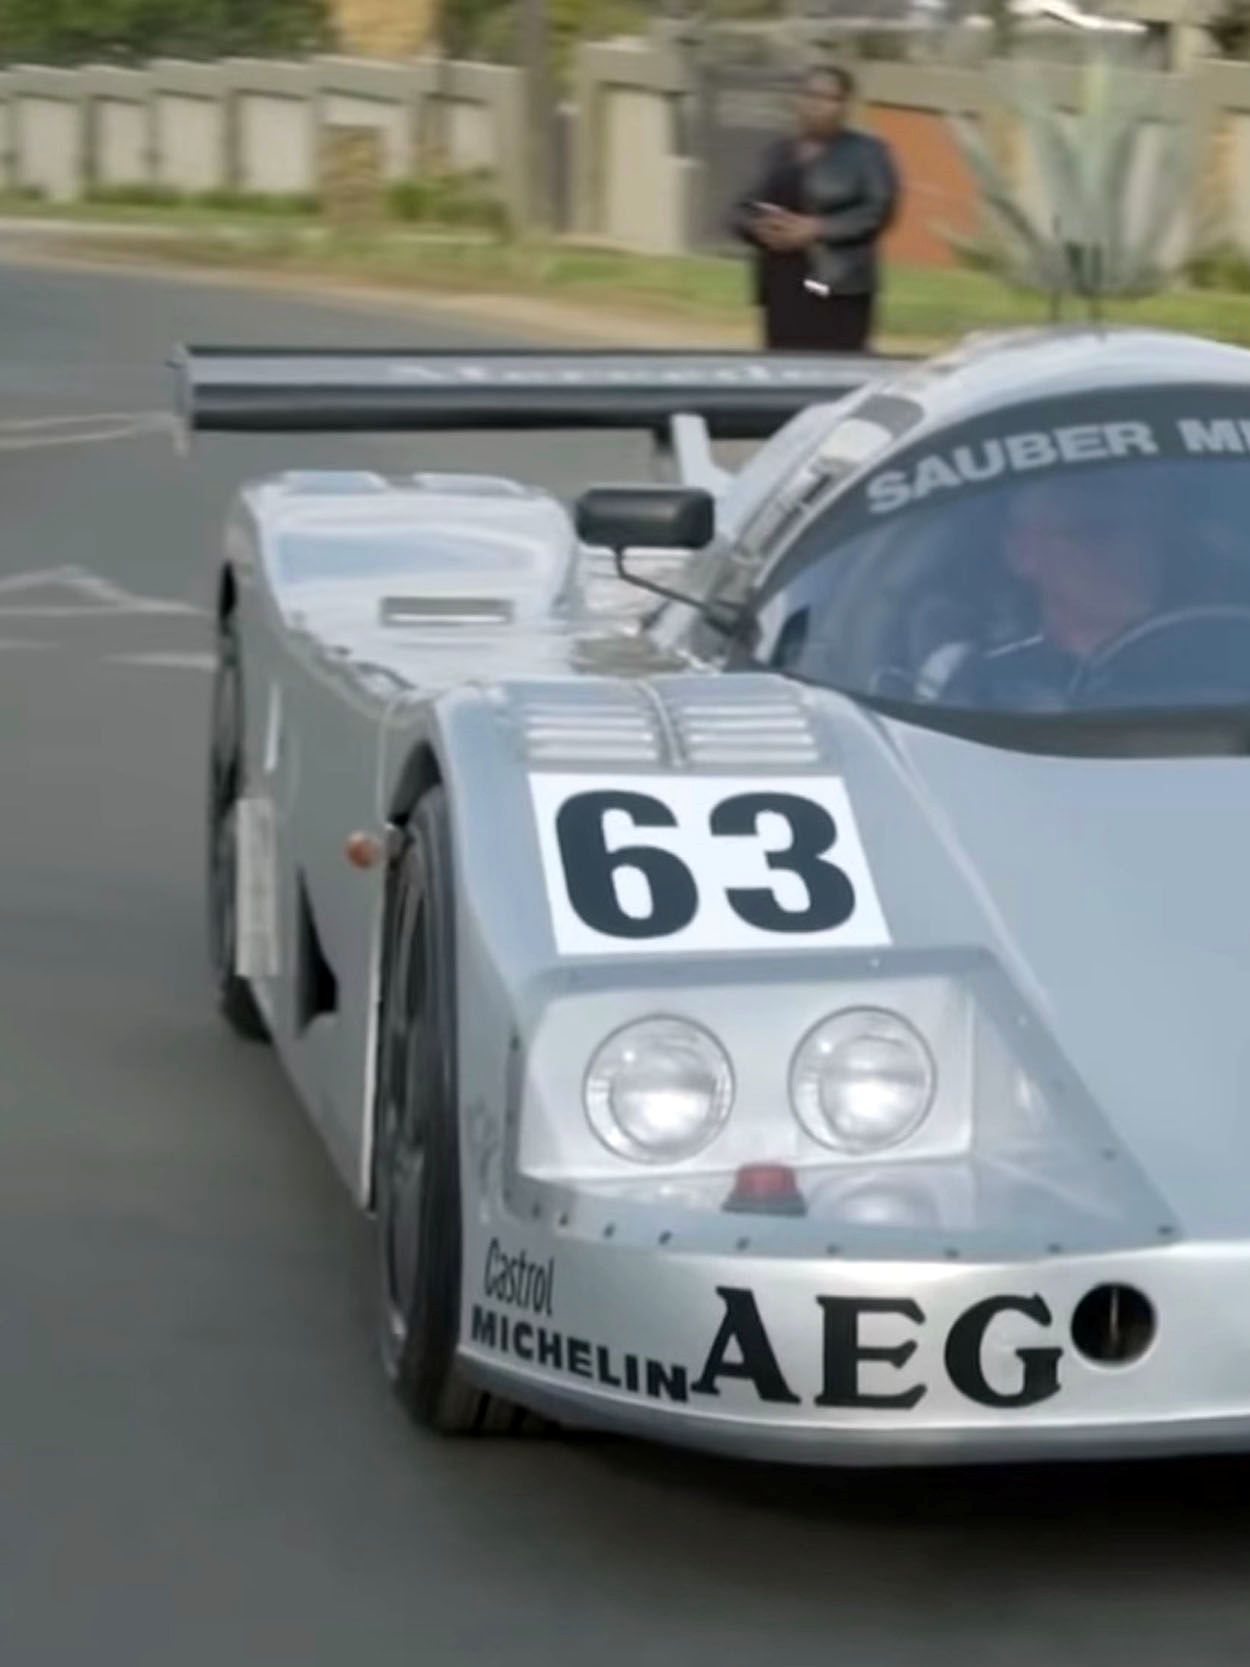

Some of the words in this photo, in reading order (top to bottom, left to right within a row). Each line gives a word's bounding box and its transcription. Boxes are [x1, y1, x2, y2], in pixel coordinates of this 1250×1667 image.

[866, 418, 1158, 512] SAUBER
[555, 789, 856, 939] 63
[484, 1237, 555, 1316] Castrol
[471, 1303, 689, 1403] MICHELIN
[691, 1286, 1063, 1409] AEG
